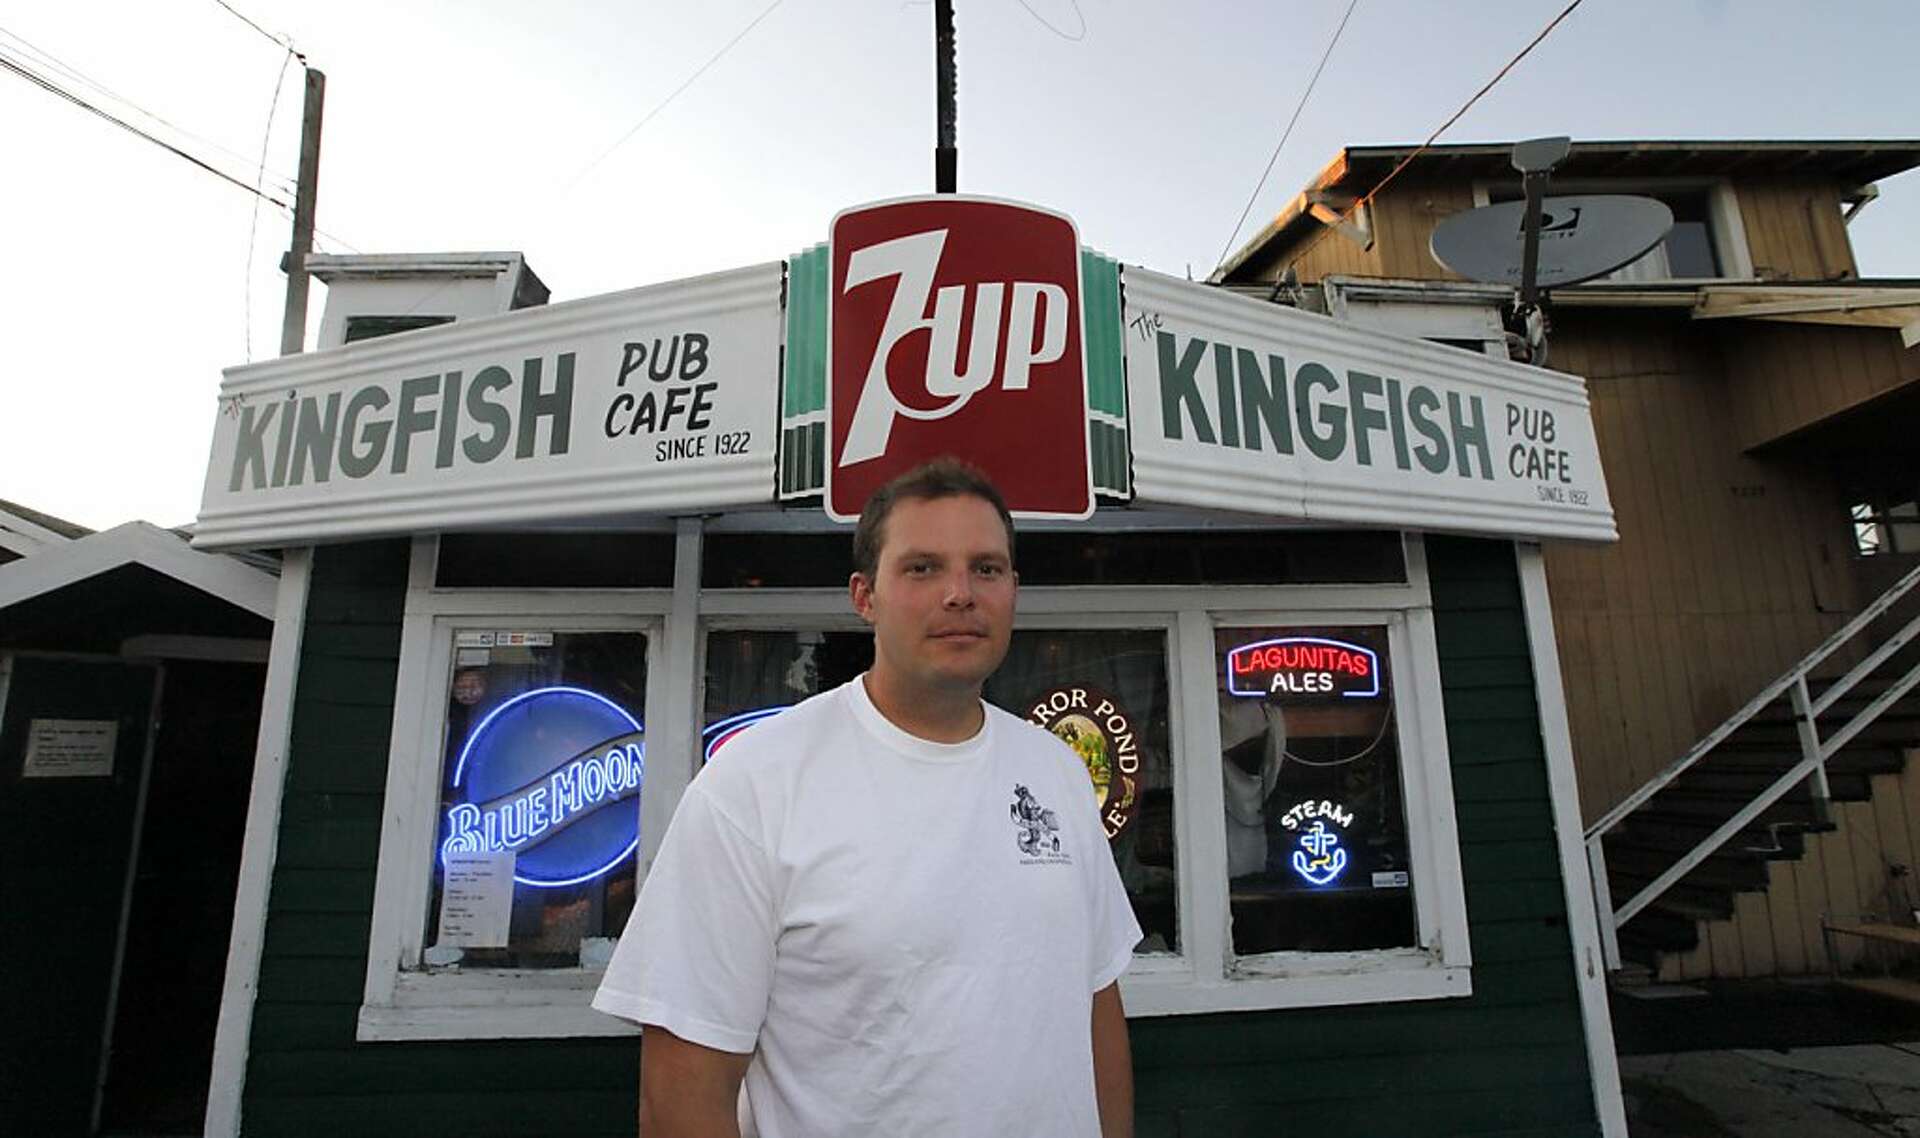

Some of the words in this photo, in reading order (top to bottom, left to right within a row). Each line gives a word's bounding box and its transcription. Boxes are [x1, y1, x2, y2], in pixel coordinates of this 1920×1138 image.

[838, 228, 1069, 469] 7UP
[1129, 311, 1164, 342] The
[617, 333, 709, 387] PUB
[229, 351, 577, 493] KINGFISH
[605, 382, 718, 438] CAFE
[1156, 330, 1495, 481] KINGFISH
[1505, 402, 1555, 444] PUB
[655, 435, 707, 462] SINCE
[715, 432, 751, 455] 1922
[1508, 443, 1572, 483] CAFE
[1234, 646, 1369, 677] LAGUNITAS
[1270, 672, 1334, 693] ALES
[1024, 689, 1088, 729] ROR
[1094, 699, 1140, 774] POND
[441, 786, 550, 862] BLUE
[1281, 799, 1354, 830] STEAM
